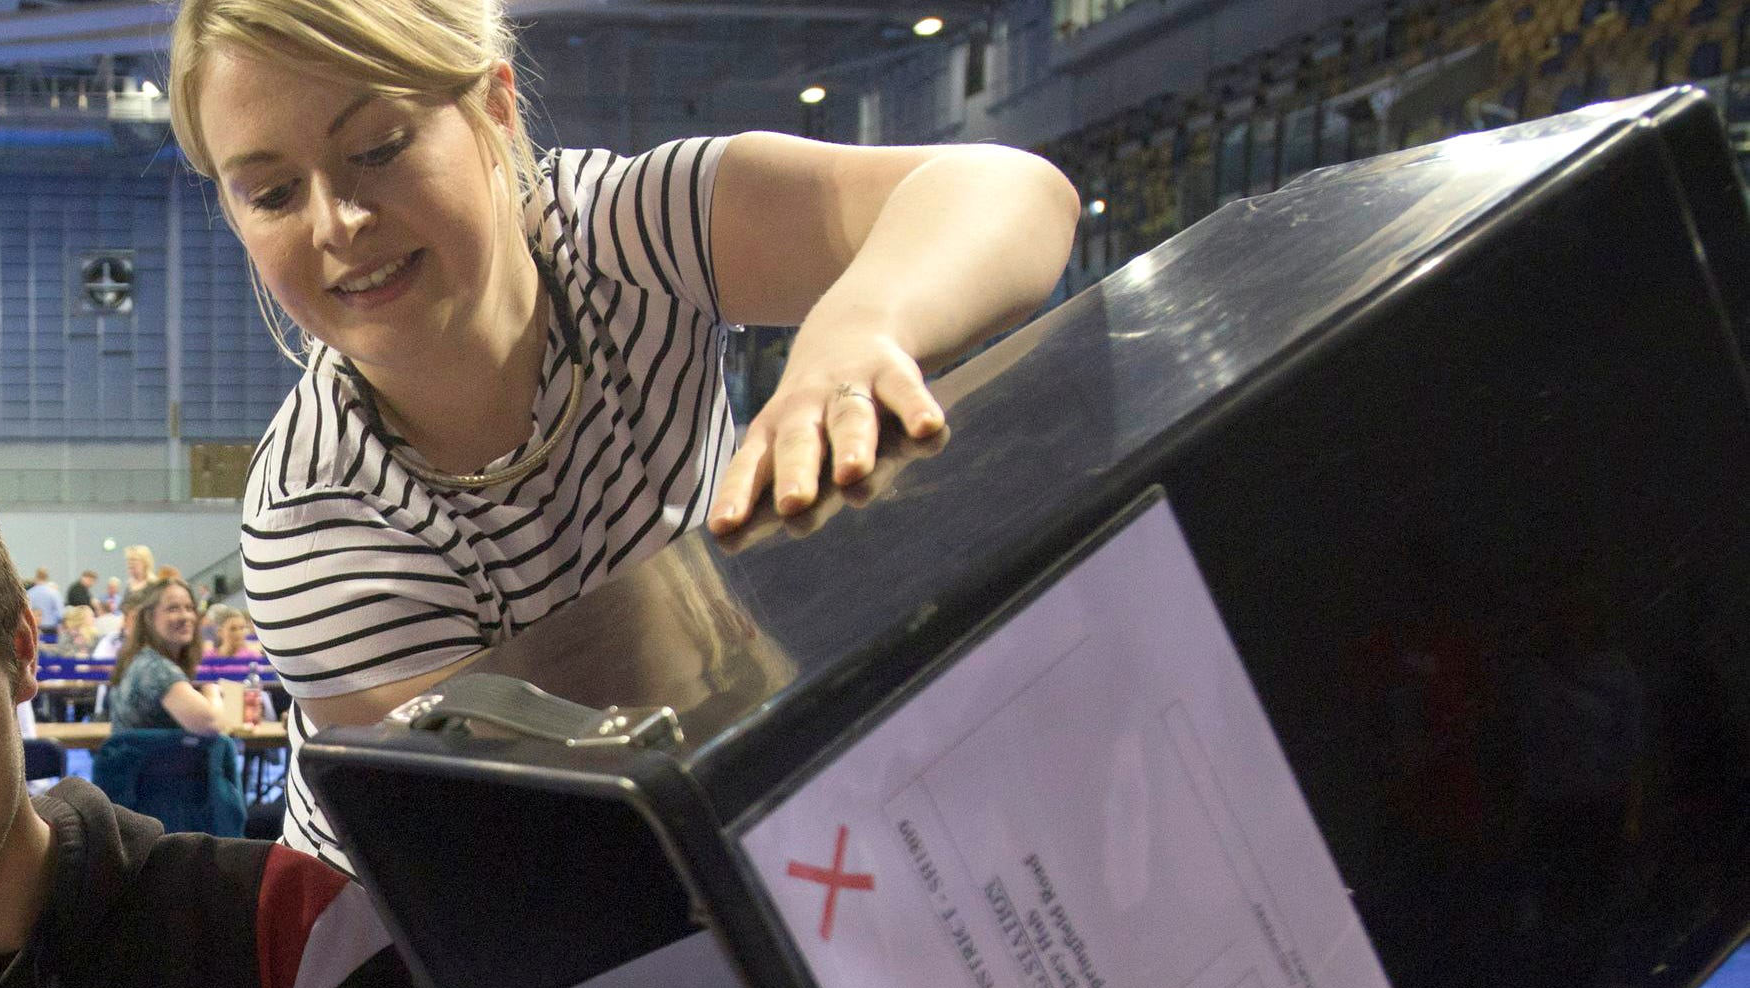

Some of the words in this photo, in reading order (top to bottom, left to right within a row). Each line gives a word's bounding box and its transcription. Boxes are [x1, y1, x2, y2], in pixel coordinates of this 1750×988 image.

[1021, 849, 1058, 907] Road
[982, 877, 1041, 978] STATION
[1023, 907, 1054, 954] Hub
